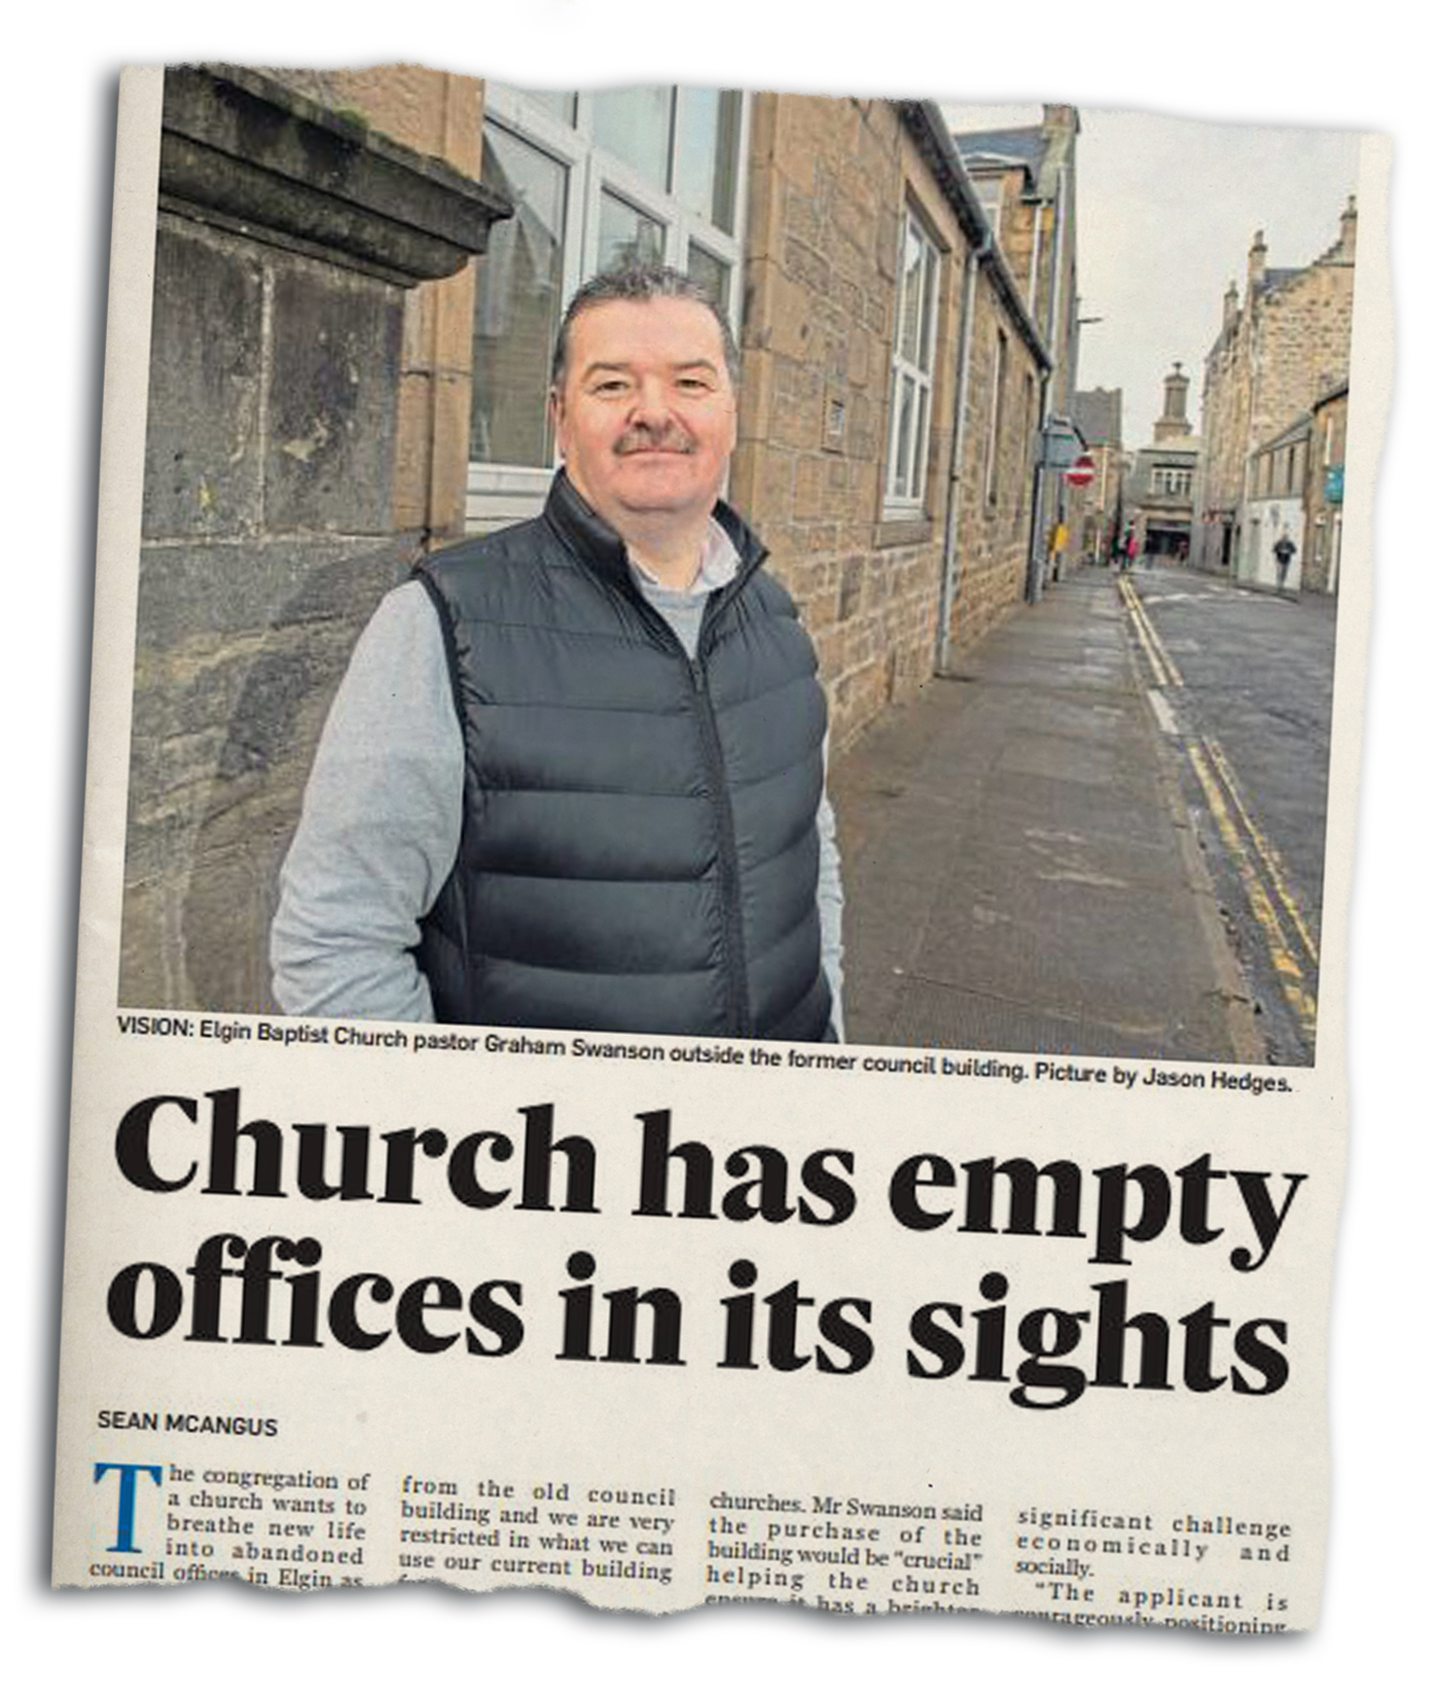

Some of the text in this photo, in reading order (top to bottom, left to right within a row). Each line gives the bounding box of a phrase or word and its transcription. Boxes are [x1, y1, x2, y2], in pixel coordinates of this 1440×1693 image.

[117, 1016, 1292, 1096] VISION: Elgin Baptist Church pastor Graham Swanson outside the former council building. Picture by Jason Hedges.
[115, 1087, 1309, 1273] Church has empty
[106, 1233, 1289, 1410] offices in its sights
[98, 1410, 277, 1437] SEAN MCANGUS
[203, 1471, 338, 1491] congregation
[348, 1473, 370, 1490] of
[403, 1475, 674, 1506] from the old council
[168, 1490, 366, 1515] a church wants to
[710, 1492, 982, 1521] churches. Mr Swanson said
[168, 1513, 365, 1540] breathe new life
[402, 1500, 674, 1534] building and we are very
[1019, 1507, 1290, 1541] significant challenge
[401, 1528, 672, 1555] restricted in what we can
[710, 1516, 981, 1546] the purchase of the
[166, 1538, 363, 1564] into abandoned
[708, 1540, 792, 1566] building
[797, 1547, 859, 1565] would
[866, 1548, 889, 1566] be
[1017, 1537, 1289, 1562] economically and
[90, 1561, 164, 1578] council
[248, 1567, 267, 1584] in
[279, 1569, 331, 1589] Elgin
[399, 1555, 671, 1585] use our current building
[707, 1565, 979, 1595] helping the church
[1016, 1558, 1094, 1580] socially.
[817, 1594, 854, 1613] has
[866, 1601, 876, 1614] a
[1119, 1588, 1241, 1609] applicant
[1267, 1593, 1287, 1611] is
[1014, 1609, 1154, 1626] urageously
